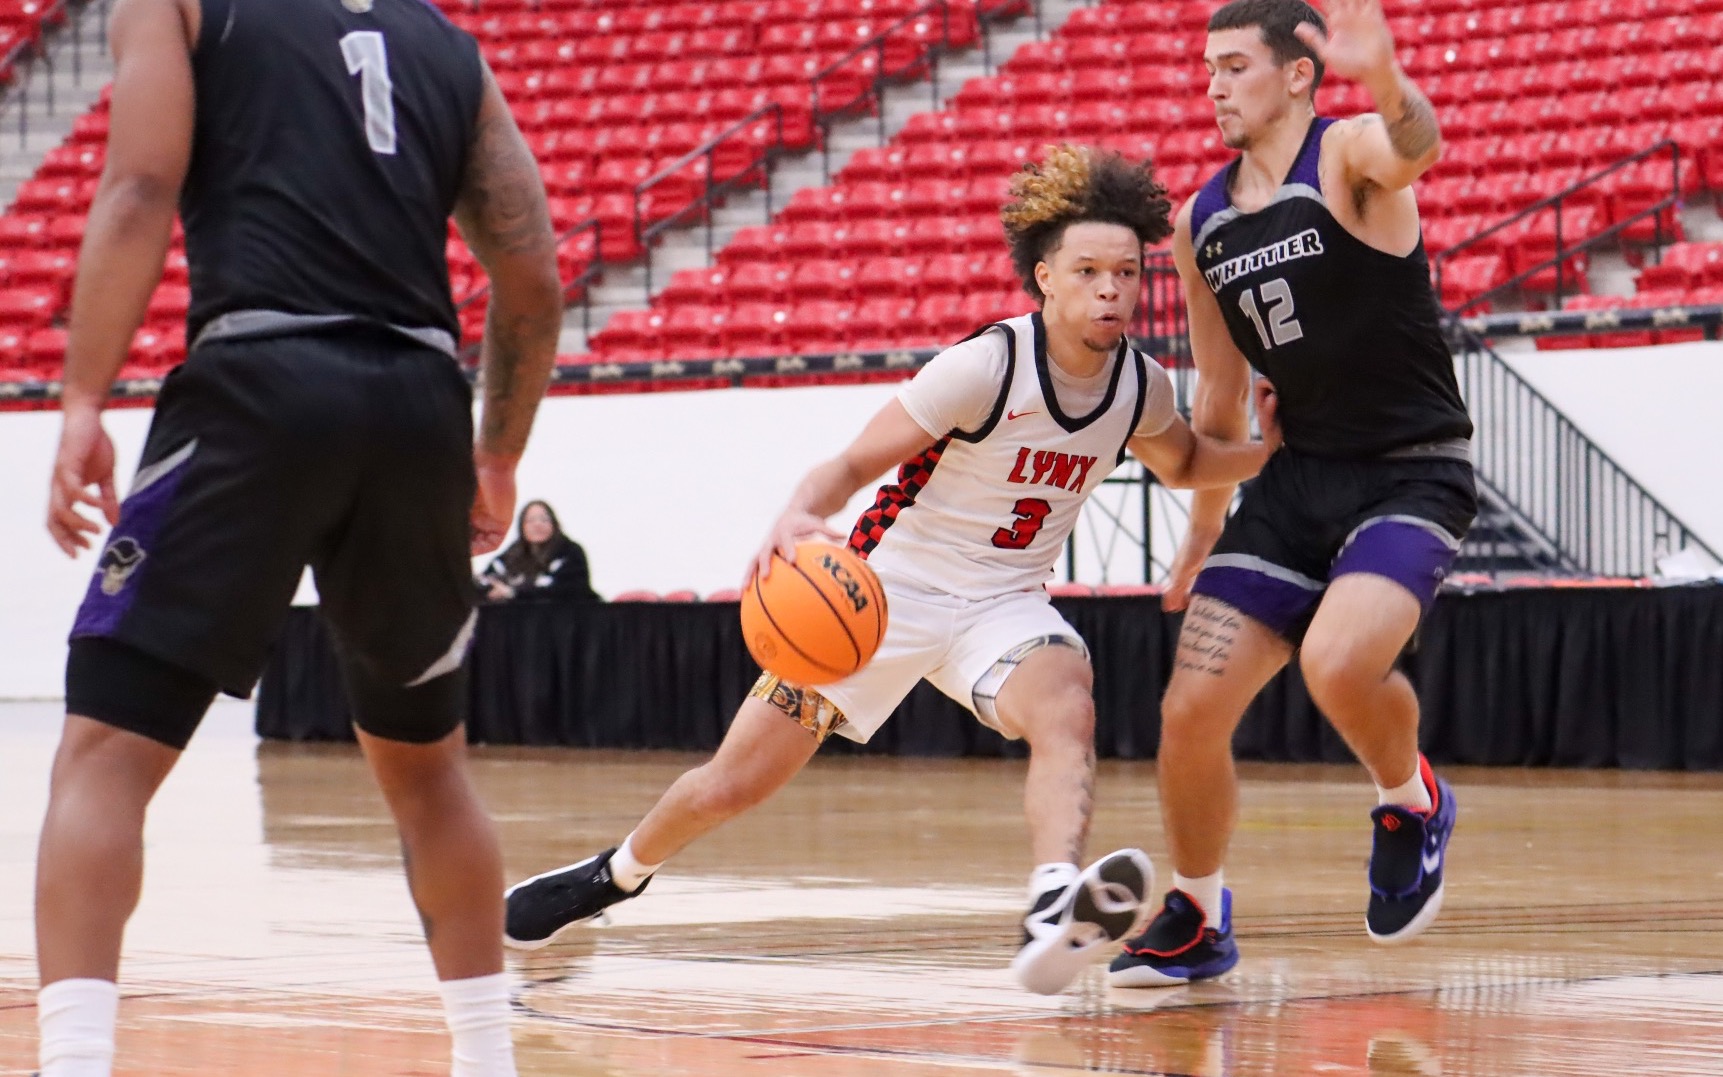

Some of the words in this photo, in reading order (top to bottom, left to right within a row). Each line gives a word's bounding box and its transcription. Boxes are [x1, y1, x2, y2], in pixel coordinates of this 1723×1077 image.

[338, 30, 397, 155] 1
[1204, 228, 1325, 294] WHITTIER
[1238, 277, 1304, 350] 12
[1006, 446, 1098, 494] LYNX
[990, 497, 1053, 550] 3
